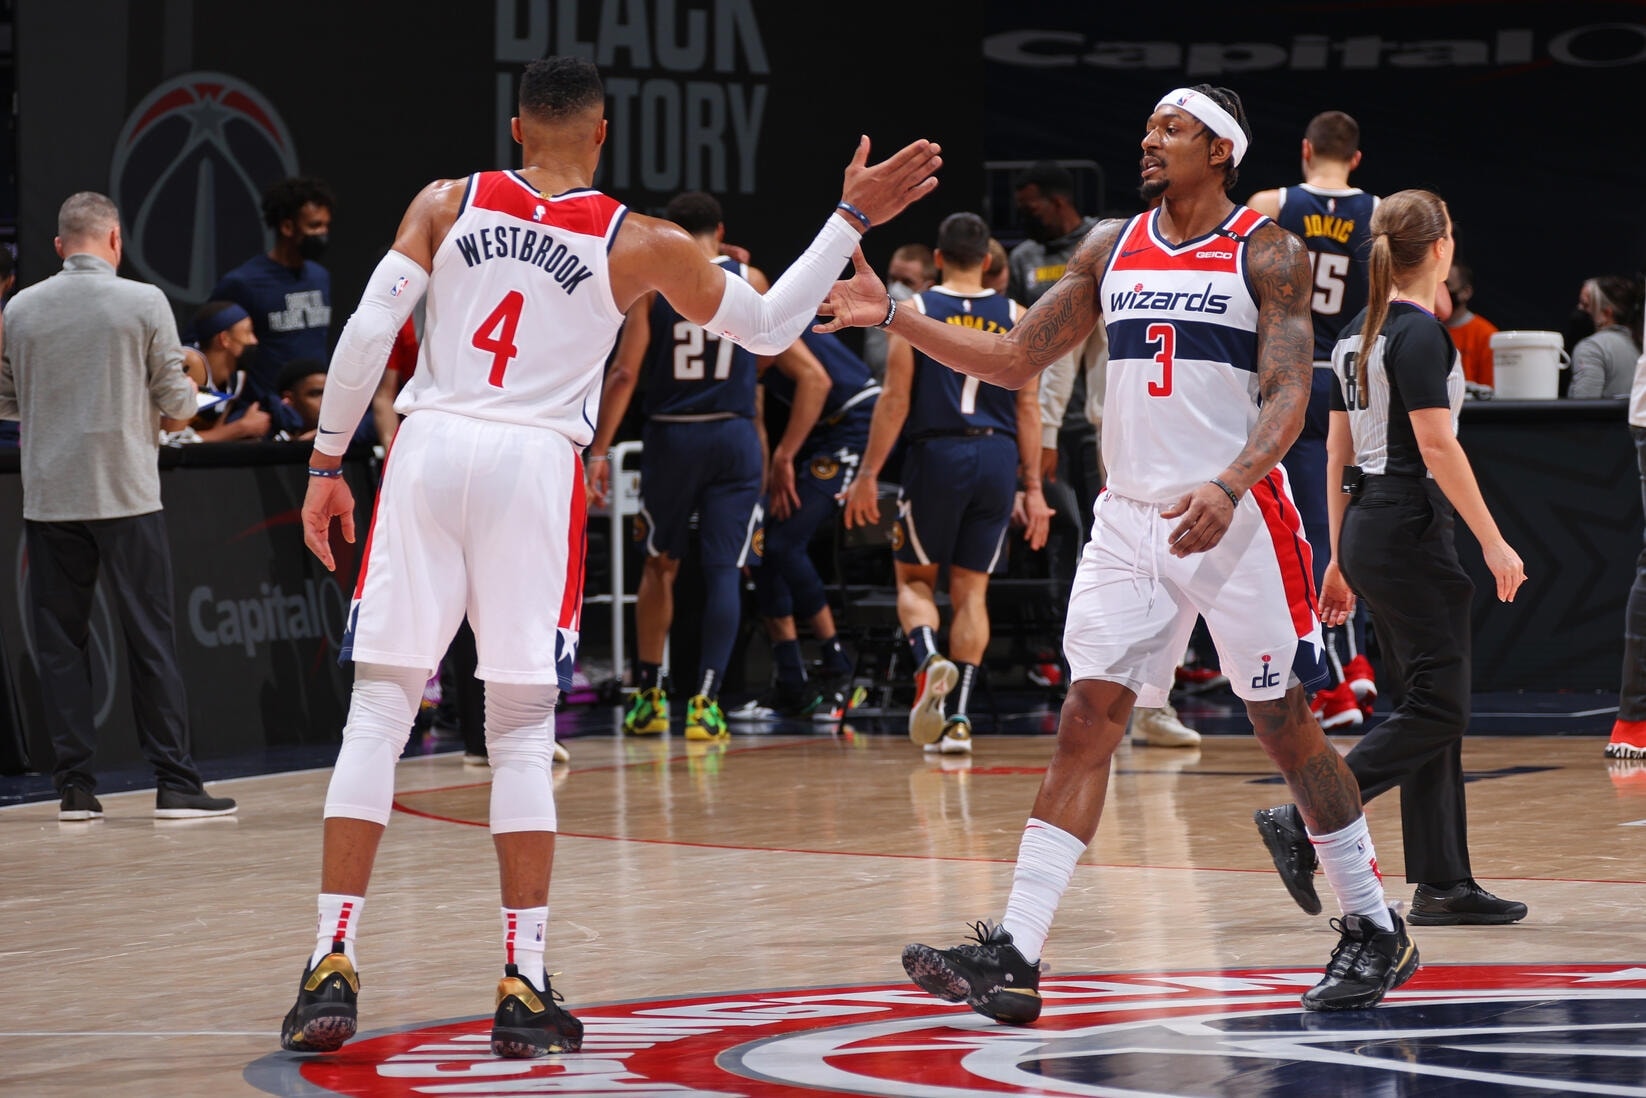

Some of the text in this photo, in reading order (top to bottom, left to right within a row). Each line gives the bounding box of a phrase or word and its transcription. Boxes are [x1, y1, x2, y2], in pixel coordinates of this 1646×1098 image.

[456, 226, 593, 296] WESTBROOK
[1195, 251, 1233, 260] GEICO
[471, 289, 525, 389] 4
[673, 320, 735, 380] 27
[1146, 323, 1176, 397] 3
